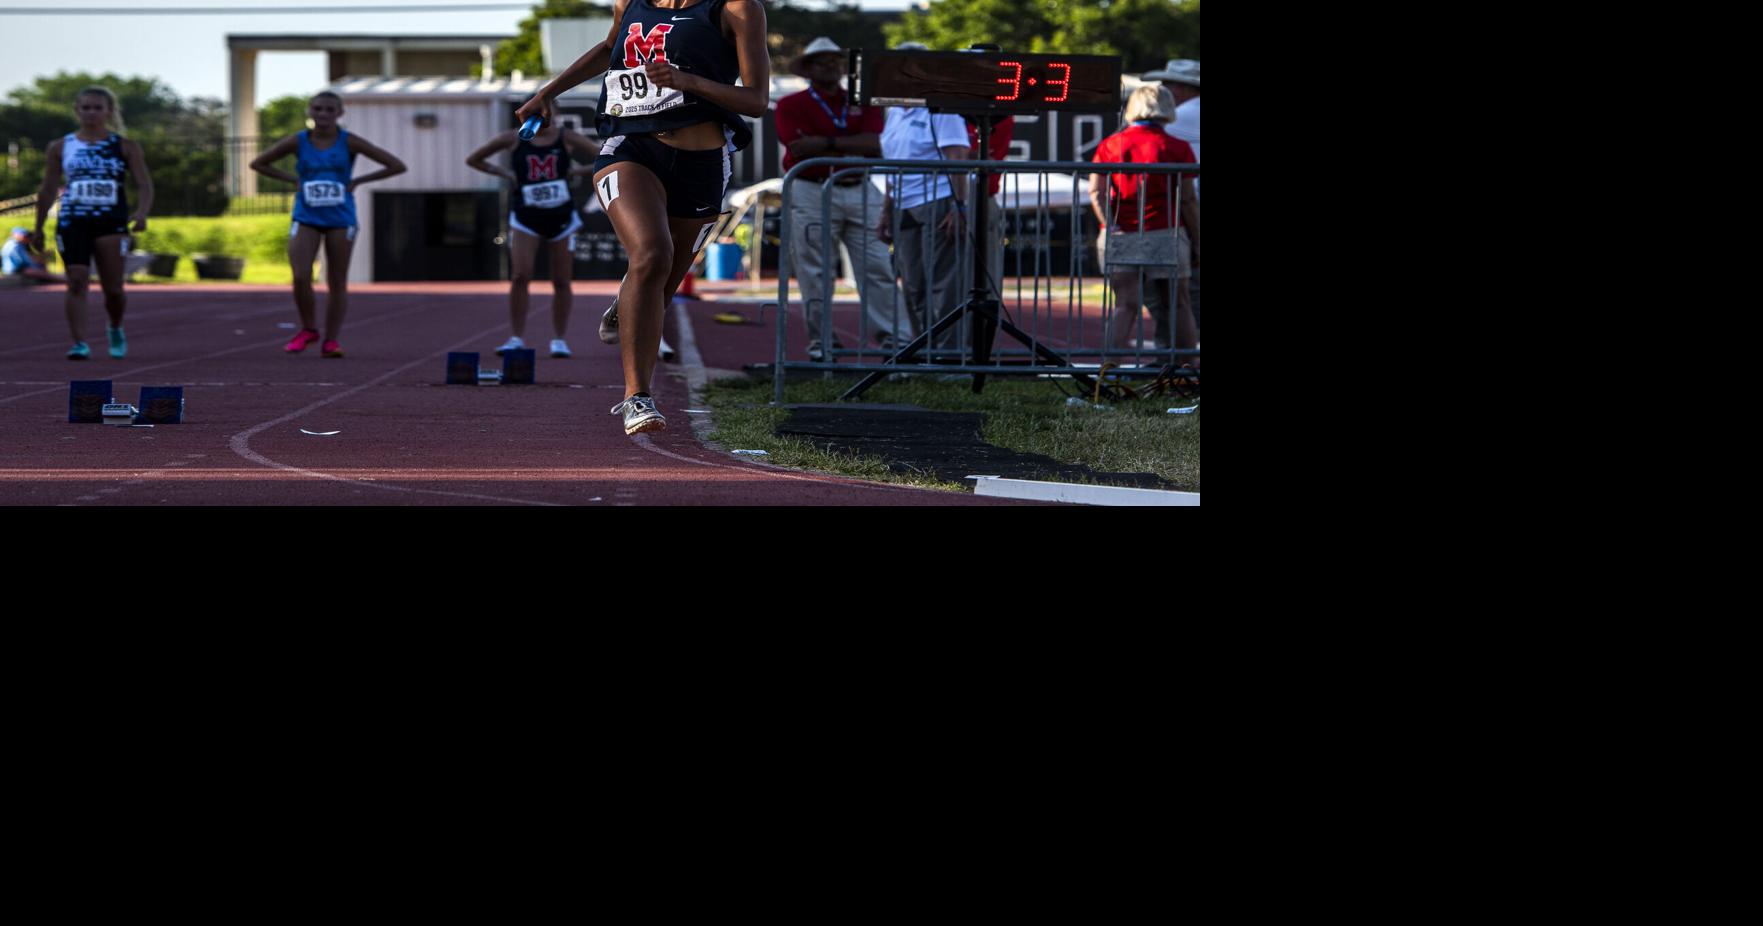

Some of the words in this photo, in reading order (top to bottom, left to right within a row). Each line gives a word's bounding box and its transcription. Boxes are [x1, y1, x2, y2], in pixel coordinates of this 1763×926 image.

[622, 22, 674, 69] M
[526, 154, 558, 180] M
[602, 176, 612, 202] 1
